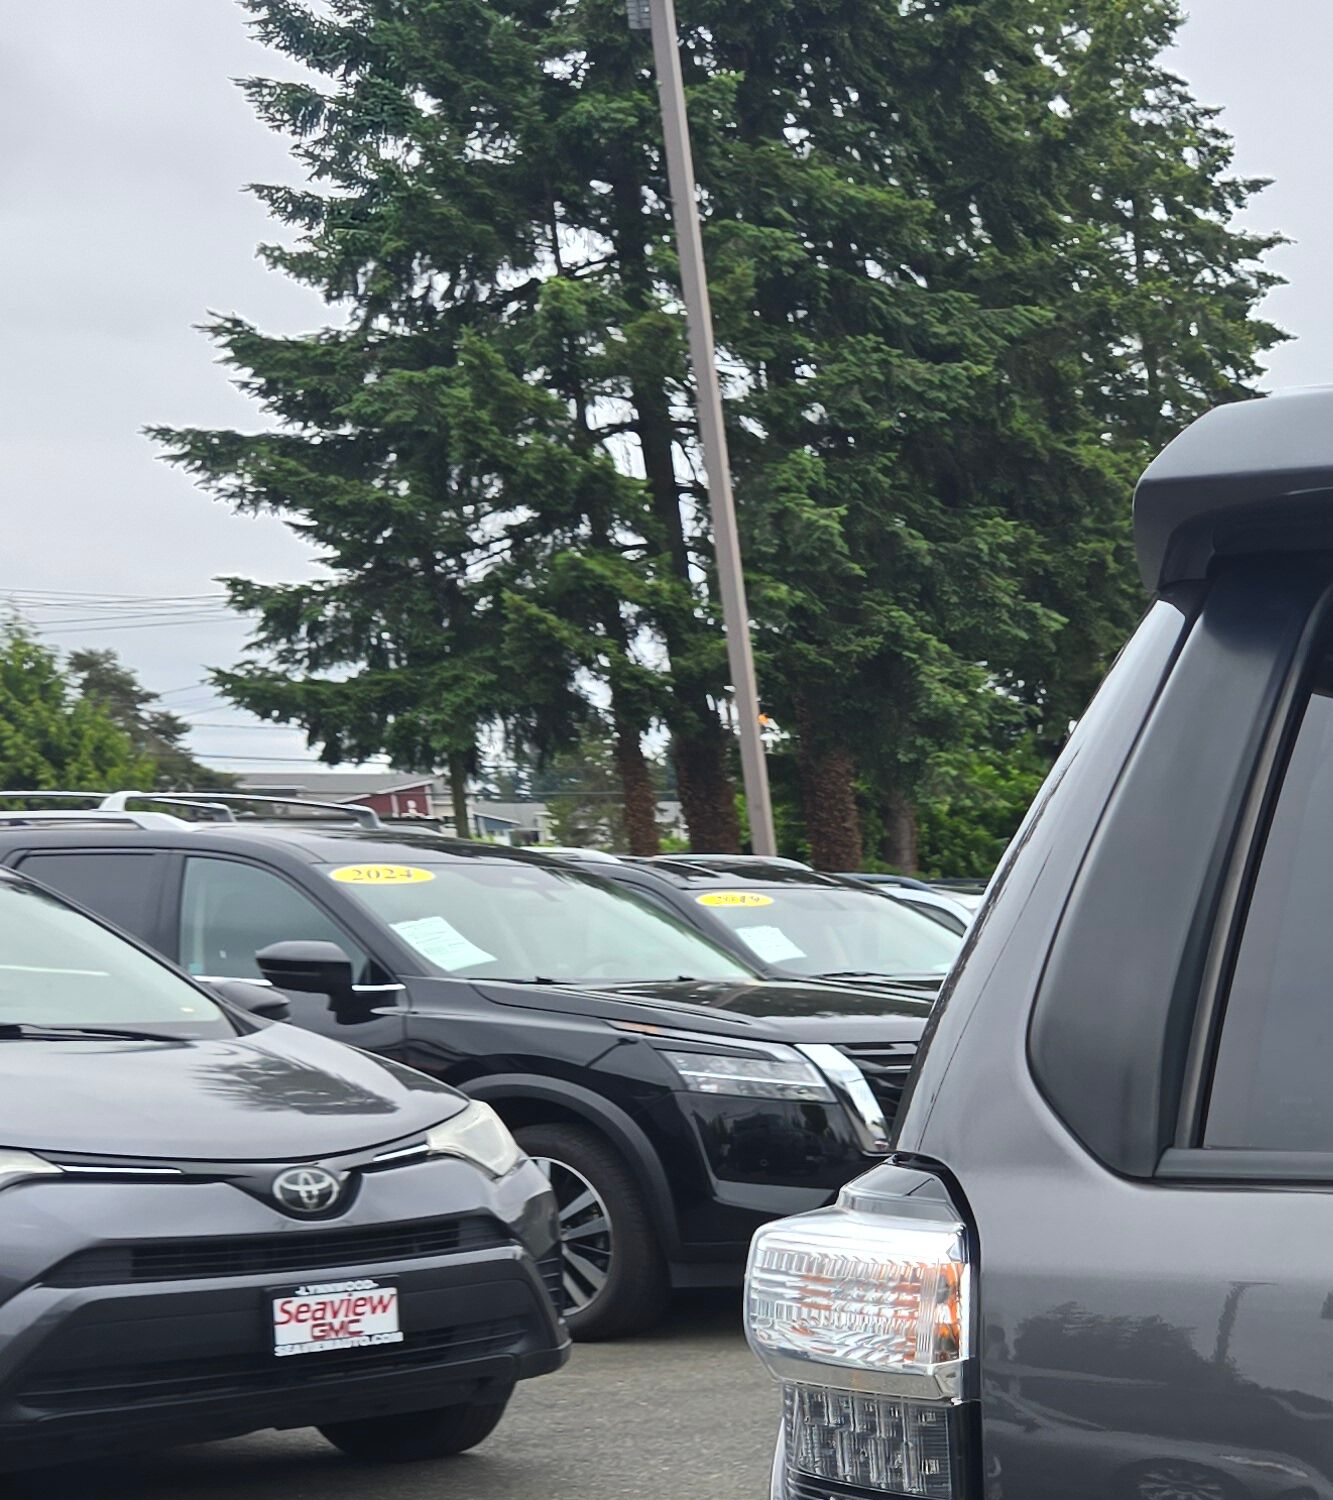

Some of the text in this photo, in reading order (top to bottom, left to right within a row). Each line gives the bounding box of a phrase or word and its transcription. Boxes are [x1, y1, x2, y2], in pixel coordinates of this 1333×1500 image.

[351, 868, 412, 881] 2024
[273, 1292, 397, 1326] Seaview
[311, 1318, 364, 1341] GMC
